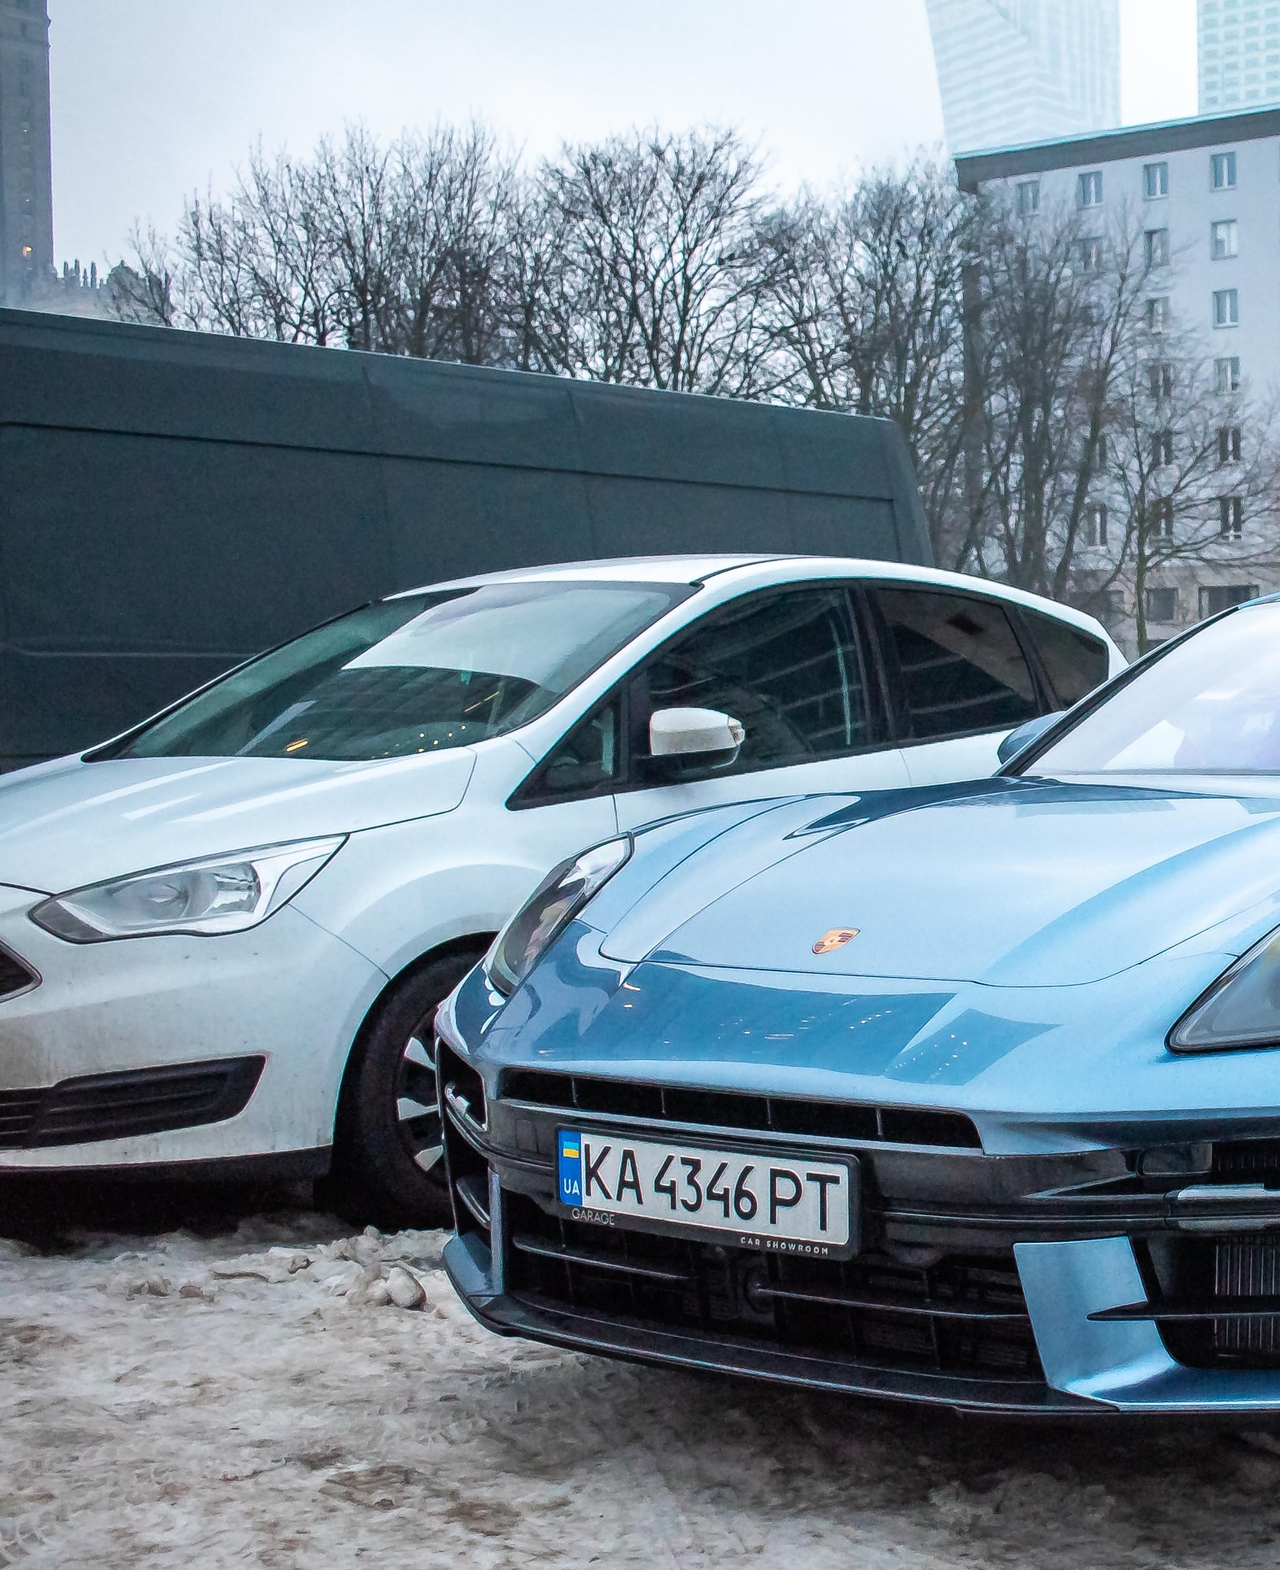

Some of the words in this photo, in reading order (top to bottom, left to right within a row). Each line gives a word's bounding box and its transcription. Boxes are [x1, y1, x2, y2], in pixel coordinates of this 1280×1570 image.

[563, 1178, 580, 1196] UA
[584, 1143, 643, 1205] KA
[654, 1154, 758, 1221] 4346
[769, 1168, 841, 1232] PT
[571, 1208, 616, 1226] GARAGE
[740, 1236, 761, 1246] CAR
[766, 1240, 829, 1255] SHOWROOM
